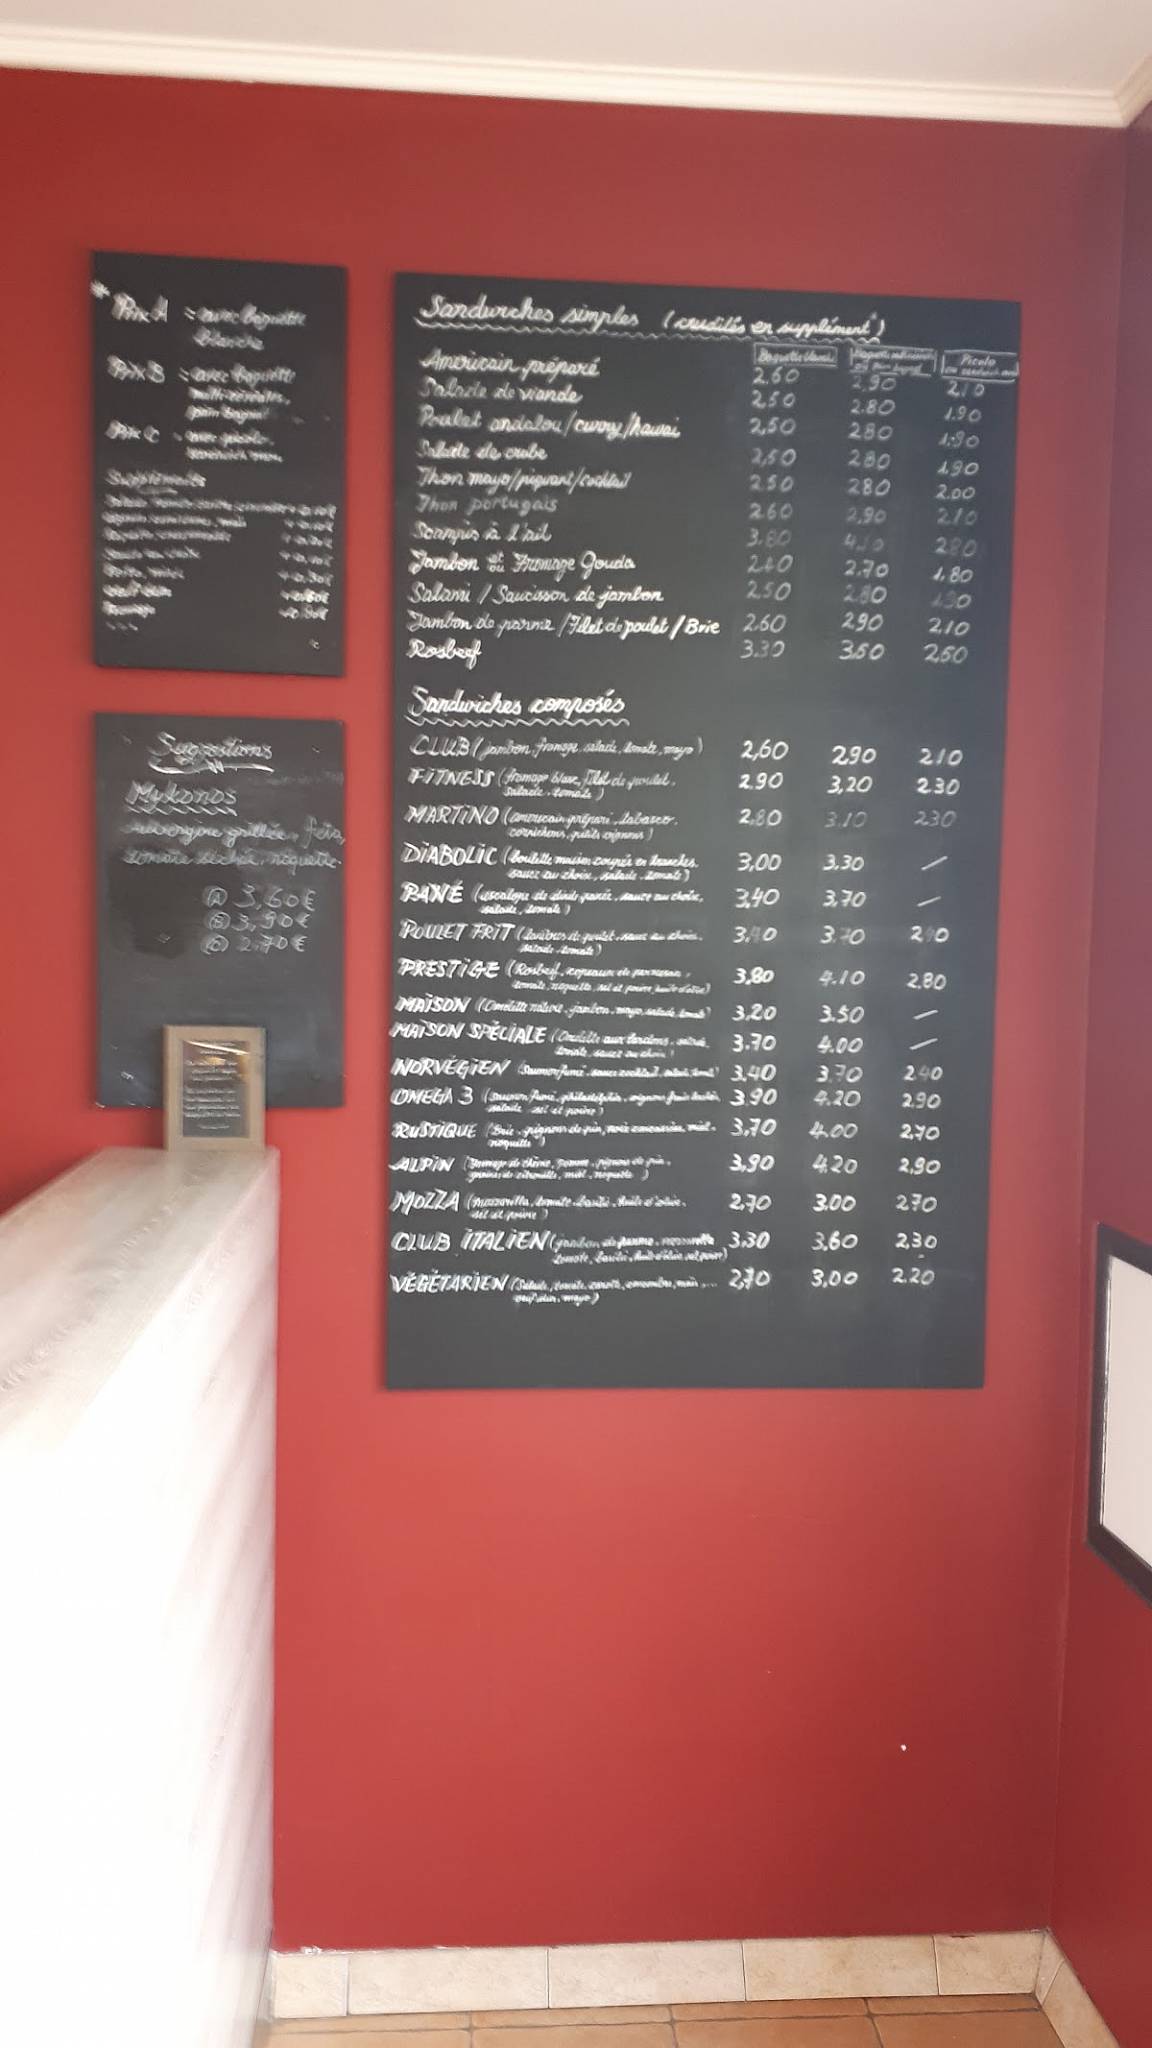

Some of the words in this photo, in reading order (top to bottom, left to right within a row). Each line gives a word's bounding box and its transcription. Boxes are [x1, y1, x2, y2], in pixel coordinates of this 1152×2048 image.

[420, 293, 553, 322] Sandwiches
[561, 303, 639, 332] simples
[751, 319, 774, 335] en
[493, 382, 515, 400] de
[518, 384, 583, 404] viande
[476, 442, 501, 461] de
[467, 495, 558, 516] portugais
[408, 548, 480, 575] Jambon
[580, 550, 636, 580] Gouda
[408, 581, 472, 605] Salami
[576, 585, 595, 602] de
[595, 586, 664, 610] jambon
[408, 608, 472, 632] Jambon
[475, 612, 494, 631] de
[408, 685, 522, 717] Sandwiches
[528, 689, 625, 719] composés
[399, 918, 468, 942] POULET
[457, 1085, 474, 1106] 3
